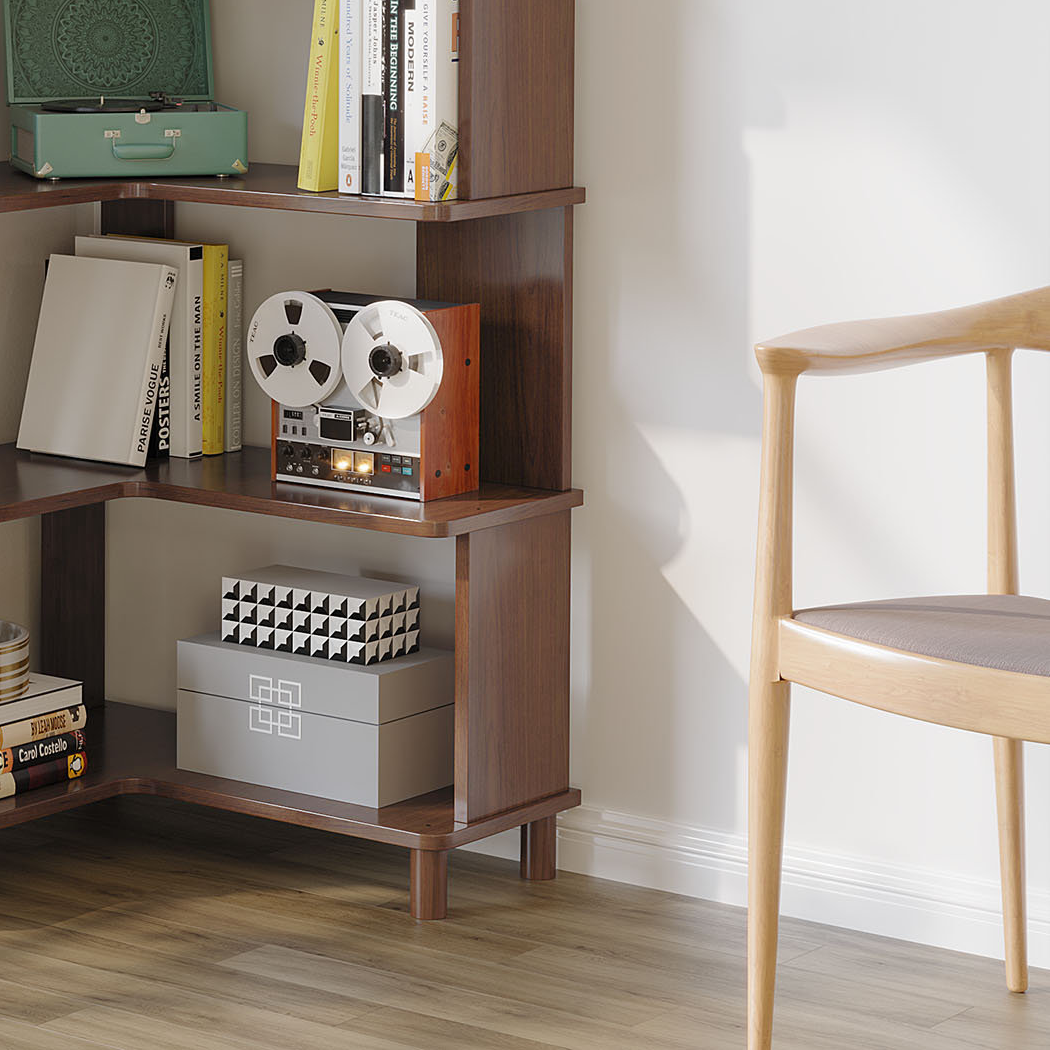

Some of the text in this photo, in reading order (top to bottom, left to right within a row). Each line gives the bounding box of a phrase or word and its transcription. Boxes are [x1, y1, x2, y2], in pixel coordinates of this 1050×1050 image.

[390, 0, 398, 14] IN
[346, 68, 353, 80] of
[390, 42, 399, 111] BEGINNING
[346, 83, 354, 124] Solitude
[408, 169, 413, 183] A
[249, 320, 259, 343] TEAC
[194, 354, 201, 371] ON
[232, 338, 241, 377] DESIGN
[232, 380, 241, 398] ON
[137, 364, 159, 453] PARISE VOGUE
[158, 376, 170, 450] POSTERS
[194, 413, 200, 421] A
[30, 722, 37, 736] BY
[37, 718, 50, 734] LEAH
[18, 745, 38, 763] Carol
[39, 738, 68, 756] Costello
